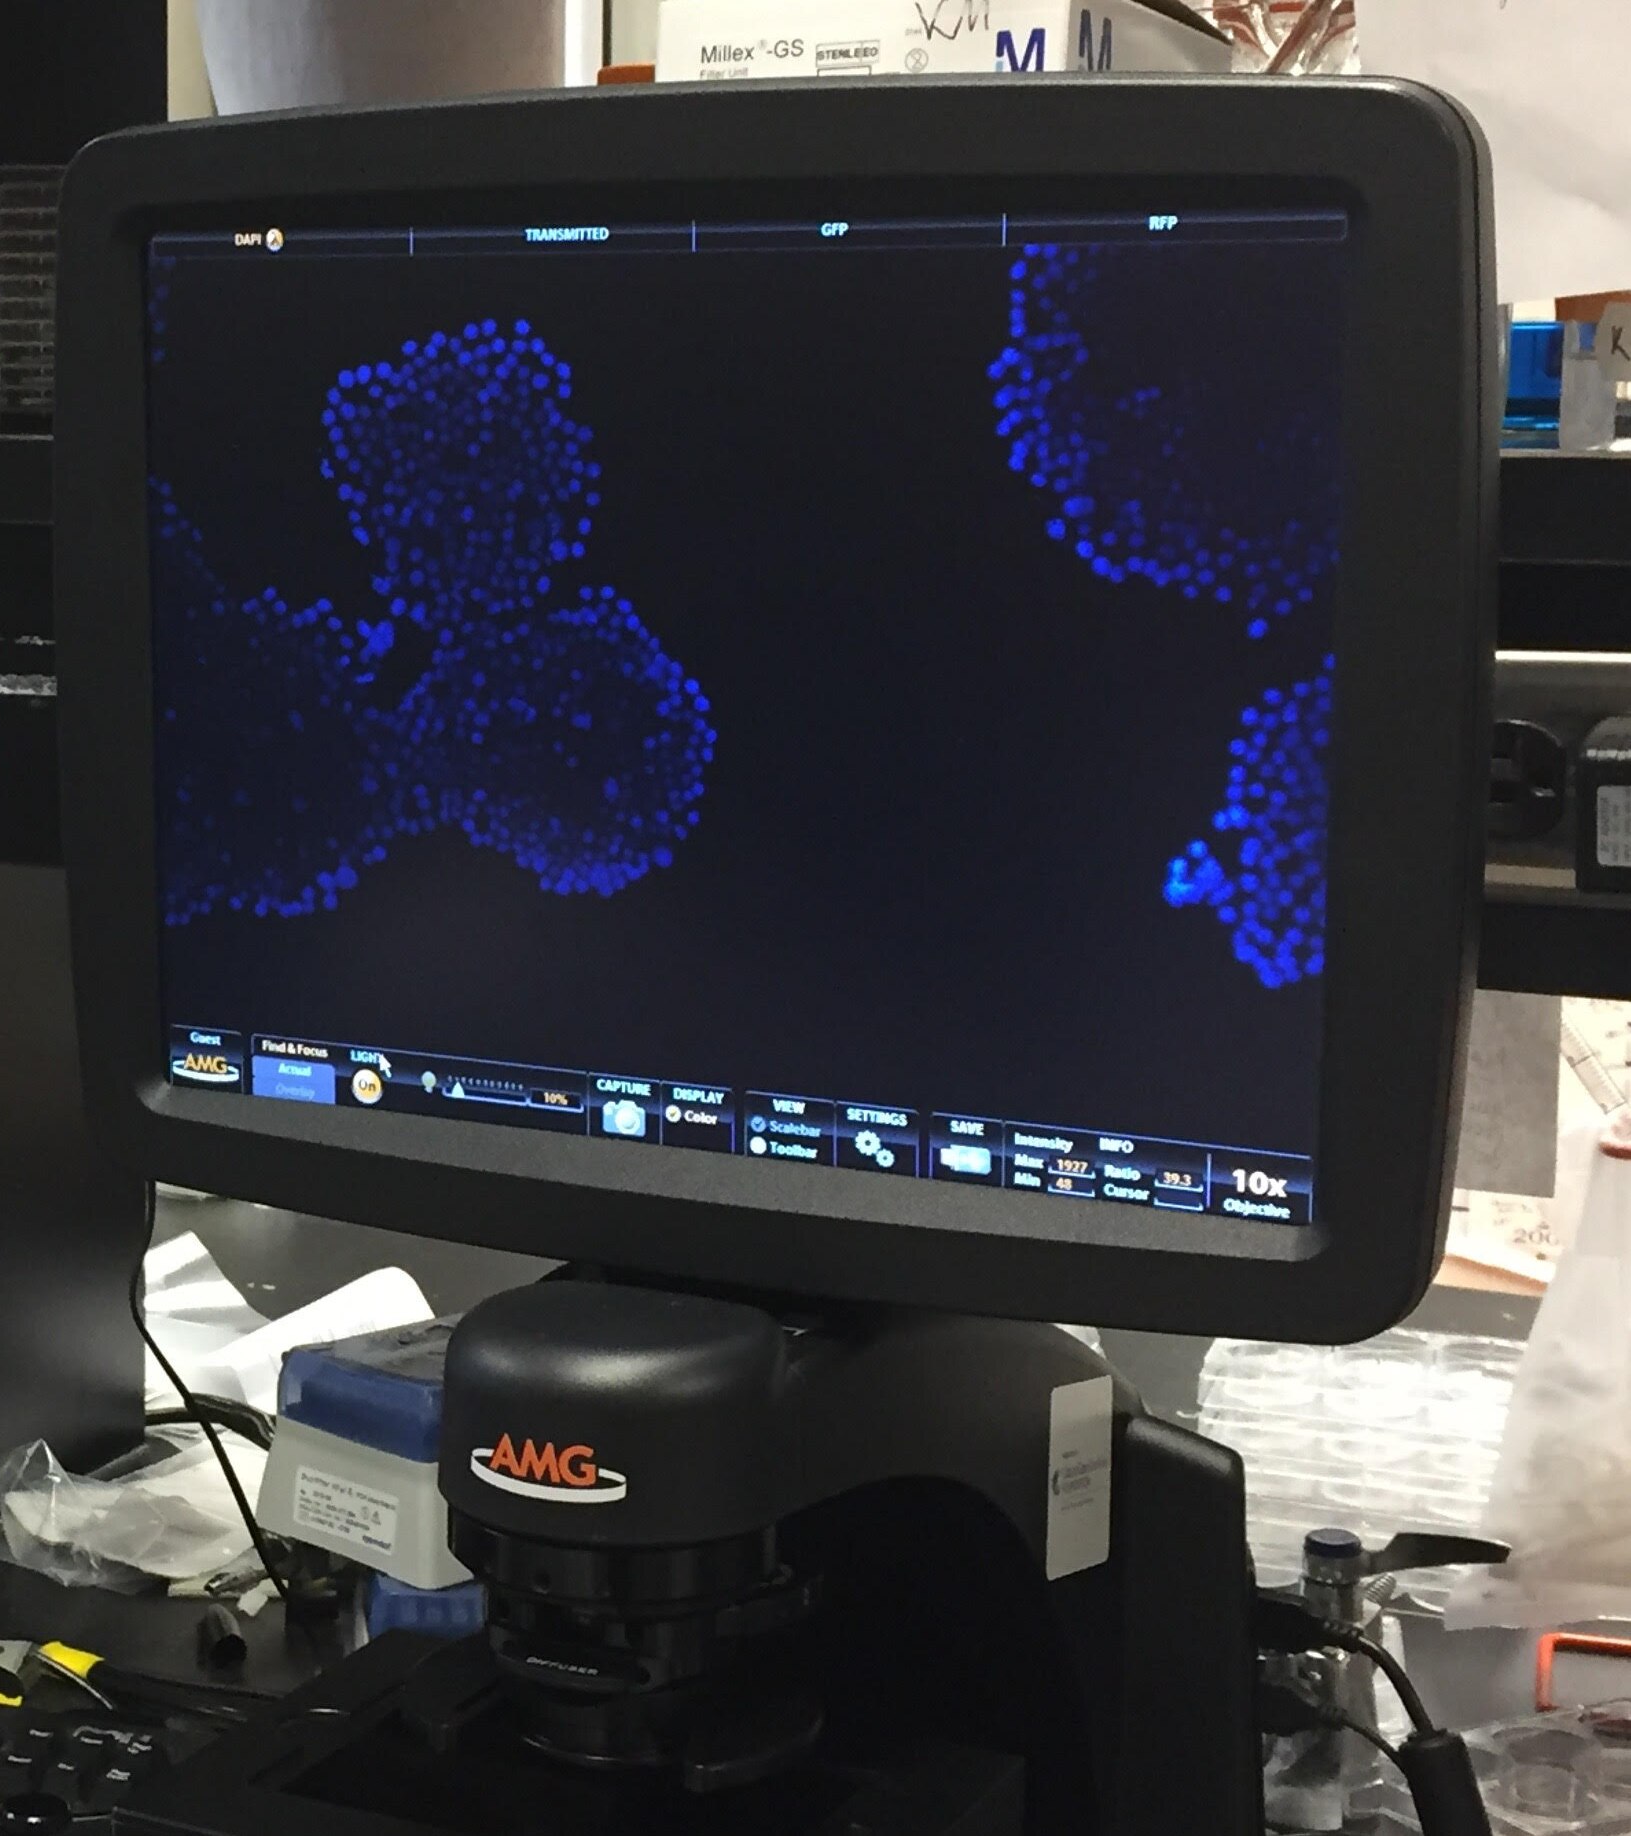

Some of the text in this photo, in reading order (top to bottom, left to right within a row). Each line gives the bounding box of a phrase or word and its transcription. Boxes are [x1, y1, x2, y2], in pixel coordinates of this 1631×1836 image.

[820, 223, 849, 237] GFP
[1148, 215, 1179, 231] RFP
[234, 233, 262, 246] DAPI
[525, 227, 610, 241] TRANSMITTED
[190, 1031, 221, 1046] Guest
[261, 1039, 285, 1053] Find
[297, 1044, 329, 1058] Focus
[184, 1052, 229, 1075] AMG
[278, 1063, 312, 1077] Actual
[358, 1078, 376, 1092] On
[596, 1078, 652, 1097] CAPTURE
[543, 1091, 568, 1106] 10%
[673, 1087, 725, 1105] DISPLAY
[772, 1098, 806, 1115] VIEW
[684, 1109, 718, 1125] Color
[846, 1107, 908, 1127] SETTINGS
[769, 1120, 821, 1138] Scalebar
[950, 1120, 985, 1136] SAVE
[769, 1141, 818, 1159] Toolbar
[1014, 1131, 1074, 1153] Intensity
[1099, 1137, 1134, 1154] INFO
[1014, 1153, 1089, 1173] Max 1927
[1013, 1172, 1042, 1187] Min
[1103, 1163, 1142, 1181] Ratio
[1103, 1183, 1150, 1200] Cursor
[1232, 1168, 1288, 1198] 10x
[1223, 1197, 1291, 1219] Objective
[489, 1432, 600, 1487] AMG
